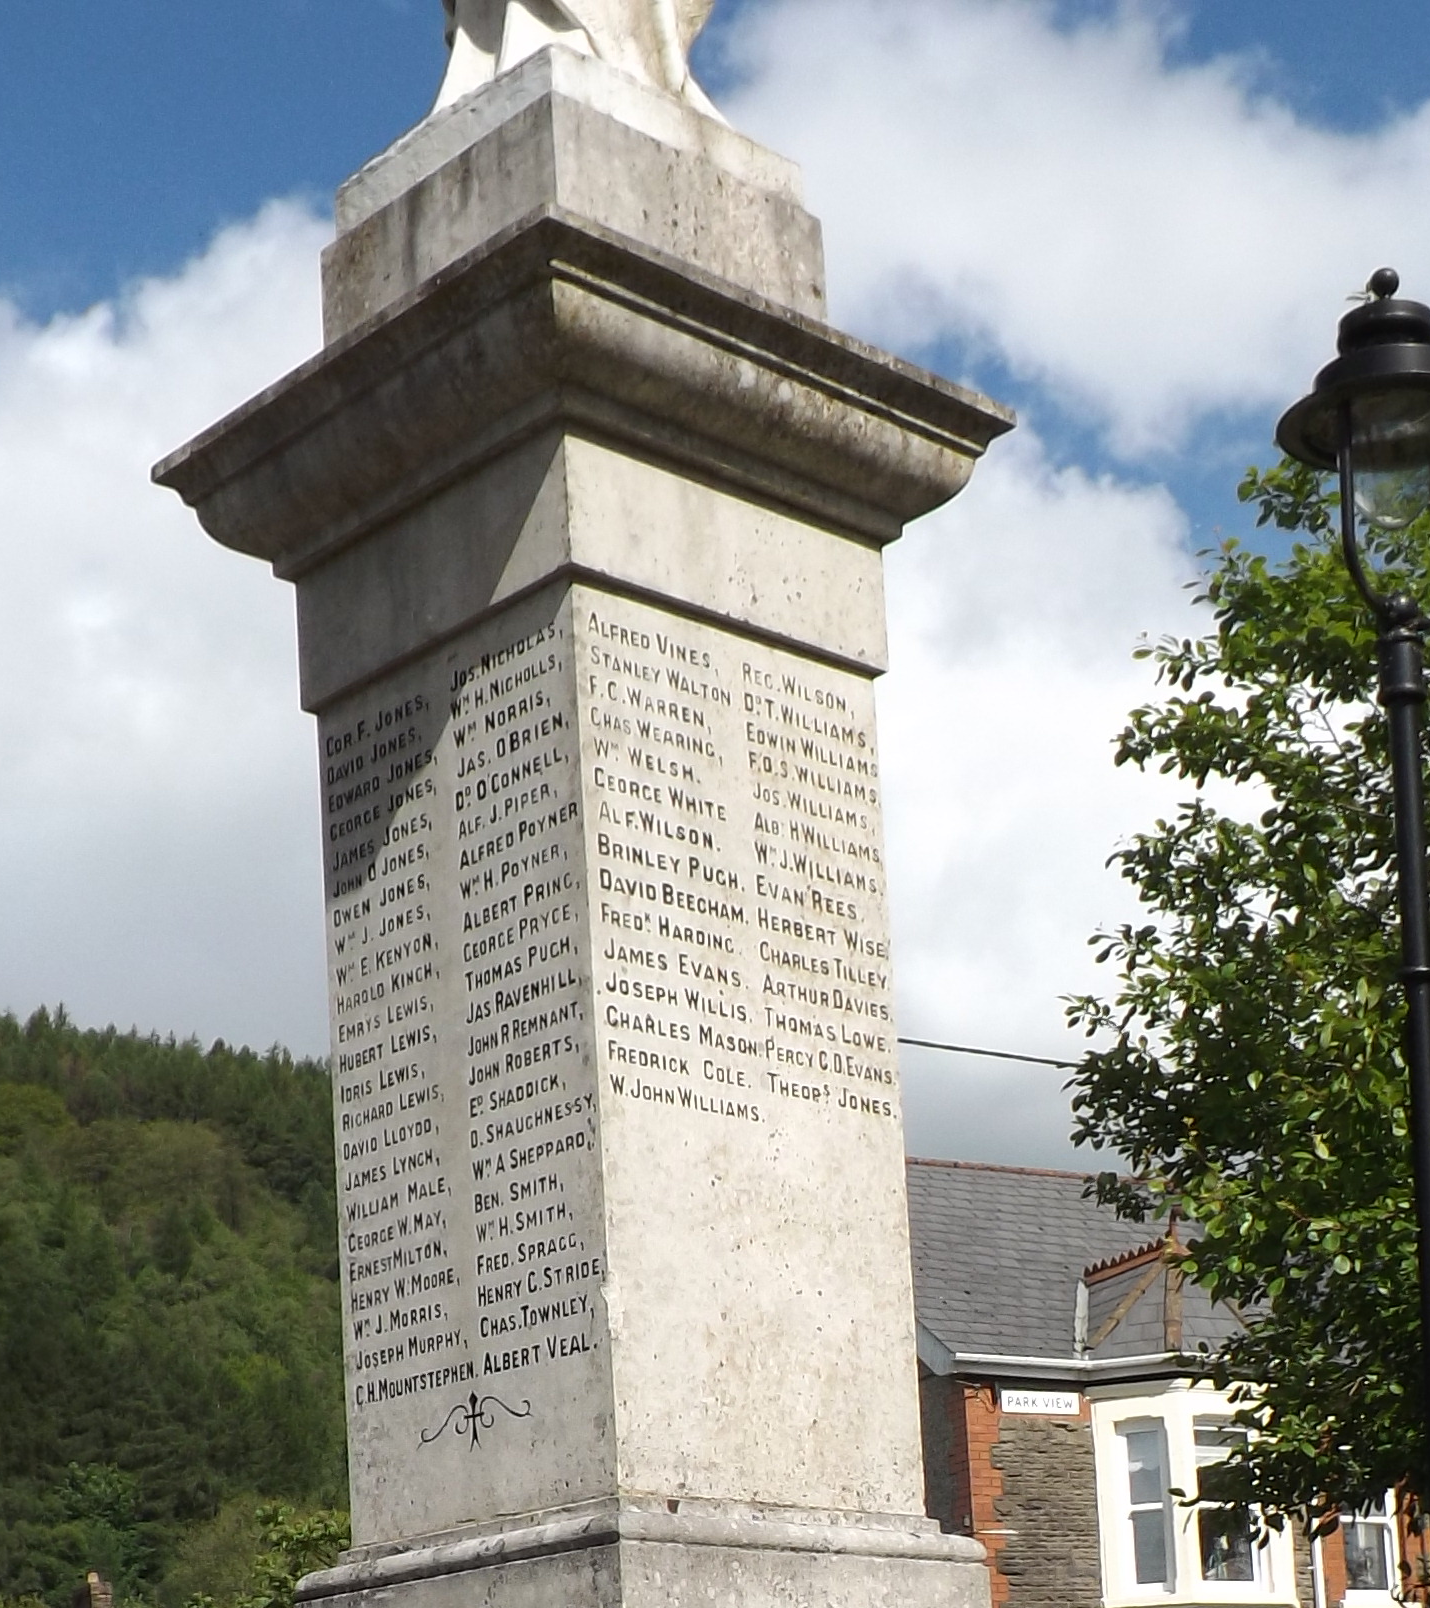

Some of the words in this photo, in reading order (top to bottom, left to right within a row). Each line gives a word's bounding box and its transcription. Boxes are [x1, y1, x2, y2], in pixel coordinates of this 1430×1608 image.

[588, 612, 650, 649] ALFRED
[591, 645, 660, 683] STANLEY
[666, 667, 731, 706] WALTON
[746, 722, 795, 754] EDWIN
[327, 756, 364, 785] DAVID
[329, 776, 380, 812] EDWARD
[669, 786, 727, 821] WHITE
[333, 839, 375, 871] JAMES
[459, 831, 514, 870] ALFRED
[598, 833, 681, 875] BRINLEY
[333, 874, 363, 898] JOHN
[599, 867, 657, 901] DAVID
[756, 874, 804, 907] EVAN
[333, 898, 370, 928] OWEN
[463, 895, 518, 933] ALBERT
[758, 907, 836, 946] HERBERT
[604, 937, 668, 971] JAMES
[760, 941, 829, 976] CHARLES
[464, 956, 522, 992] THOMAS
[606, 972, 677, 1006] JOSEPH
[337, 982, 385, 1015] HAROLD
[763, 973, 829, 1008] ARTHUR
[338, 1015, 381, 1043] EMRYS
[606, 1005, 690, 1042] CHARLES
[765, 1007, 836, 1042] THOMAS
[339, 1043, 383, 1074] HUBERT
[468, 1031, 499, 1057] JOHN
[608, 1039, 689, 1076] FREDRICK
[765, 1038, 813, 1068] PERCY
[469, 1061, 499, 1086] JOHN
[340, 1080, 373, 1104] IDRIS
[342, 1101, 393, 1132] RICHARD
[343, 1137, 378, 1160] DAVID
[345, 1165, 386, 1191] JAMES
[346, 1192, 399, 1222] WILLIAM
[349, 1256, 392, 1283] ERNEST
[351, 1286, 390, 1314] HENRY
[478, 1280, 522, 1307] HENRY
[356, 1344, 404, 1370] JOSEPH
[483, 1344, 540, 1376] ALBERT
[1007, 1396, 1038, 1408] PARK
[1043, 1397, 1073, 1409] VIEW
